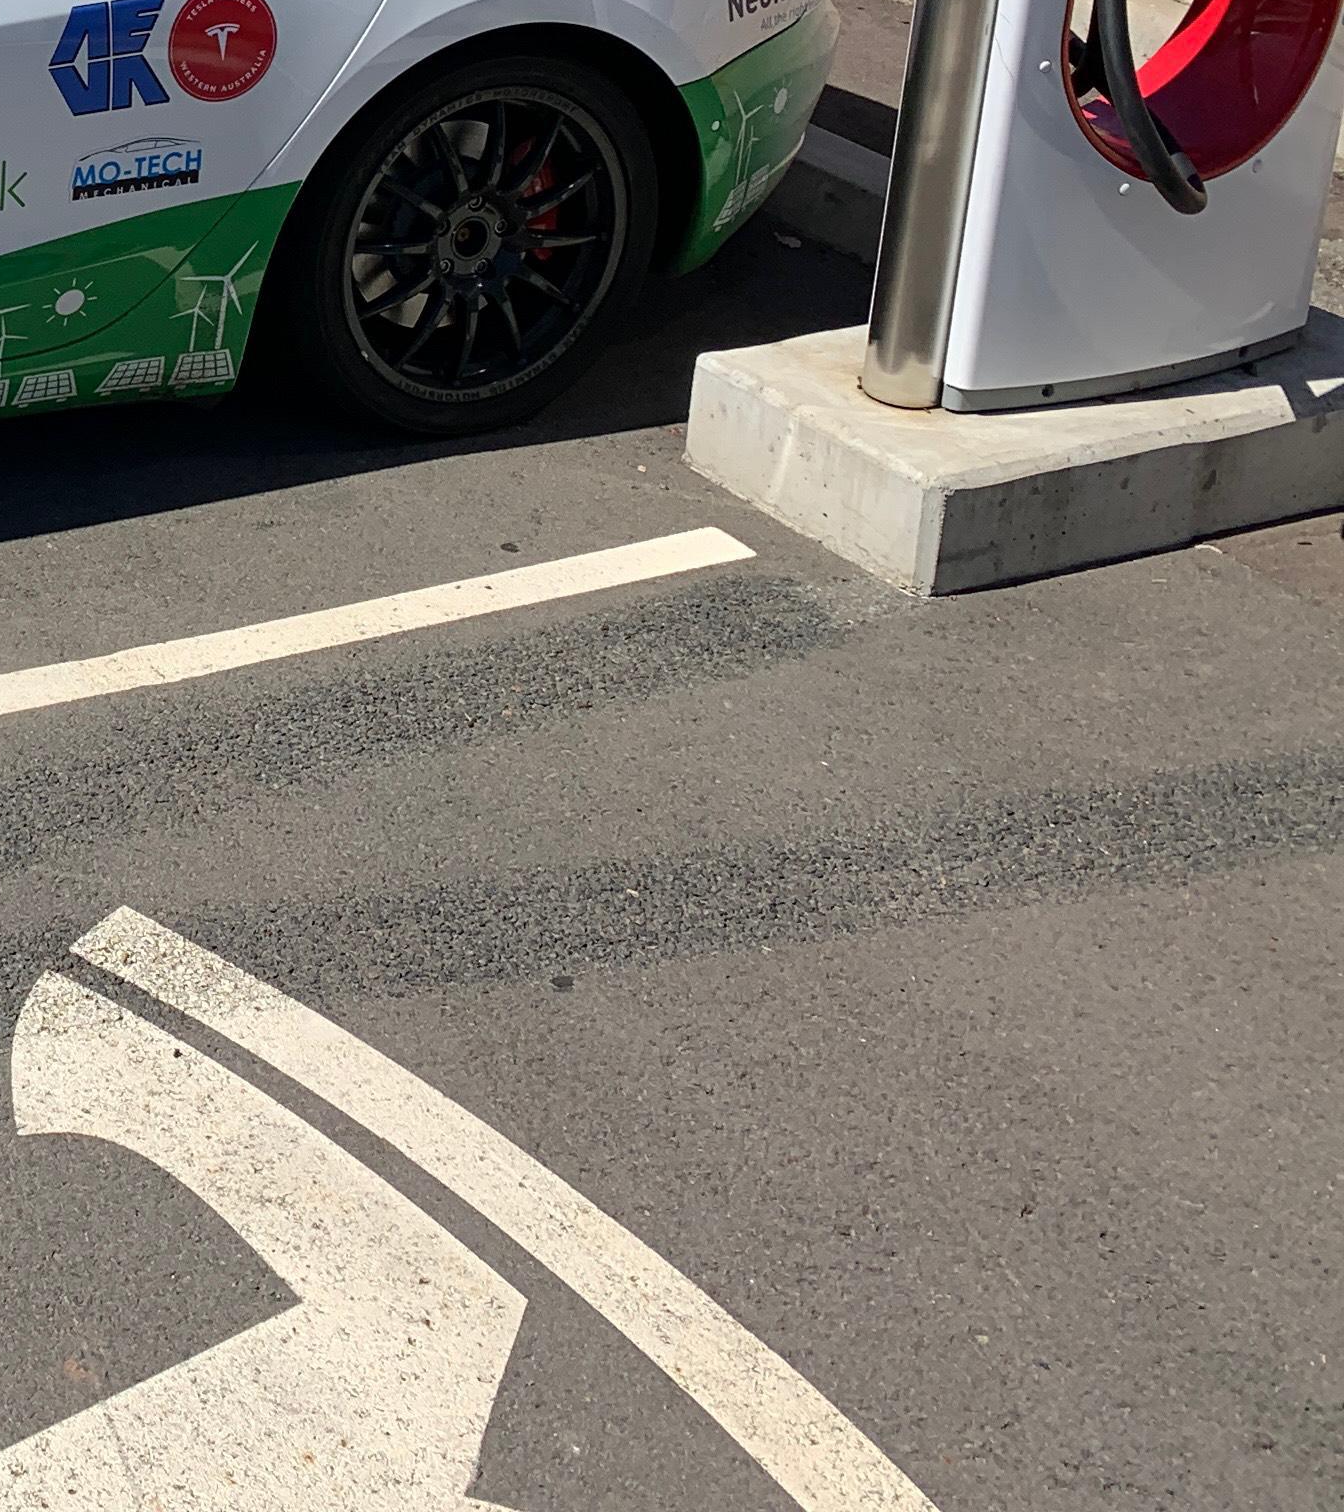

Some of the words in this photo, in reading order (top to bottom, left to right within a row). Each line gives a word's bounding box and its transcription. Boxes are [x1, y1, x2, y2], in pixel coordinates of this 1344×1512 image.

[180, 61, 217, 93] WESTERN
[220, 50, 267, 92] AUSTRALIA
[72, 149, 202, 188] MO-TECH
[79, 176, 193, 200] MECHANICAL
